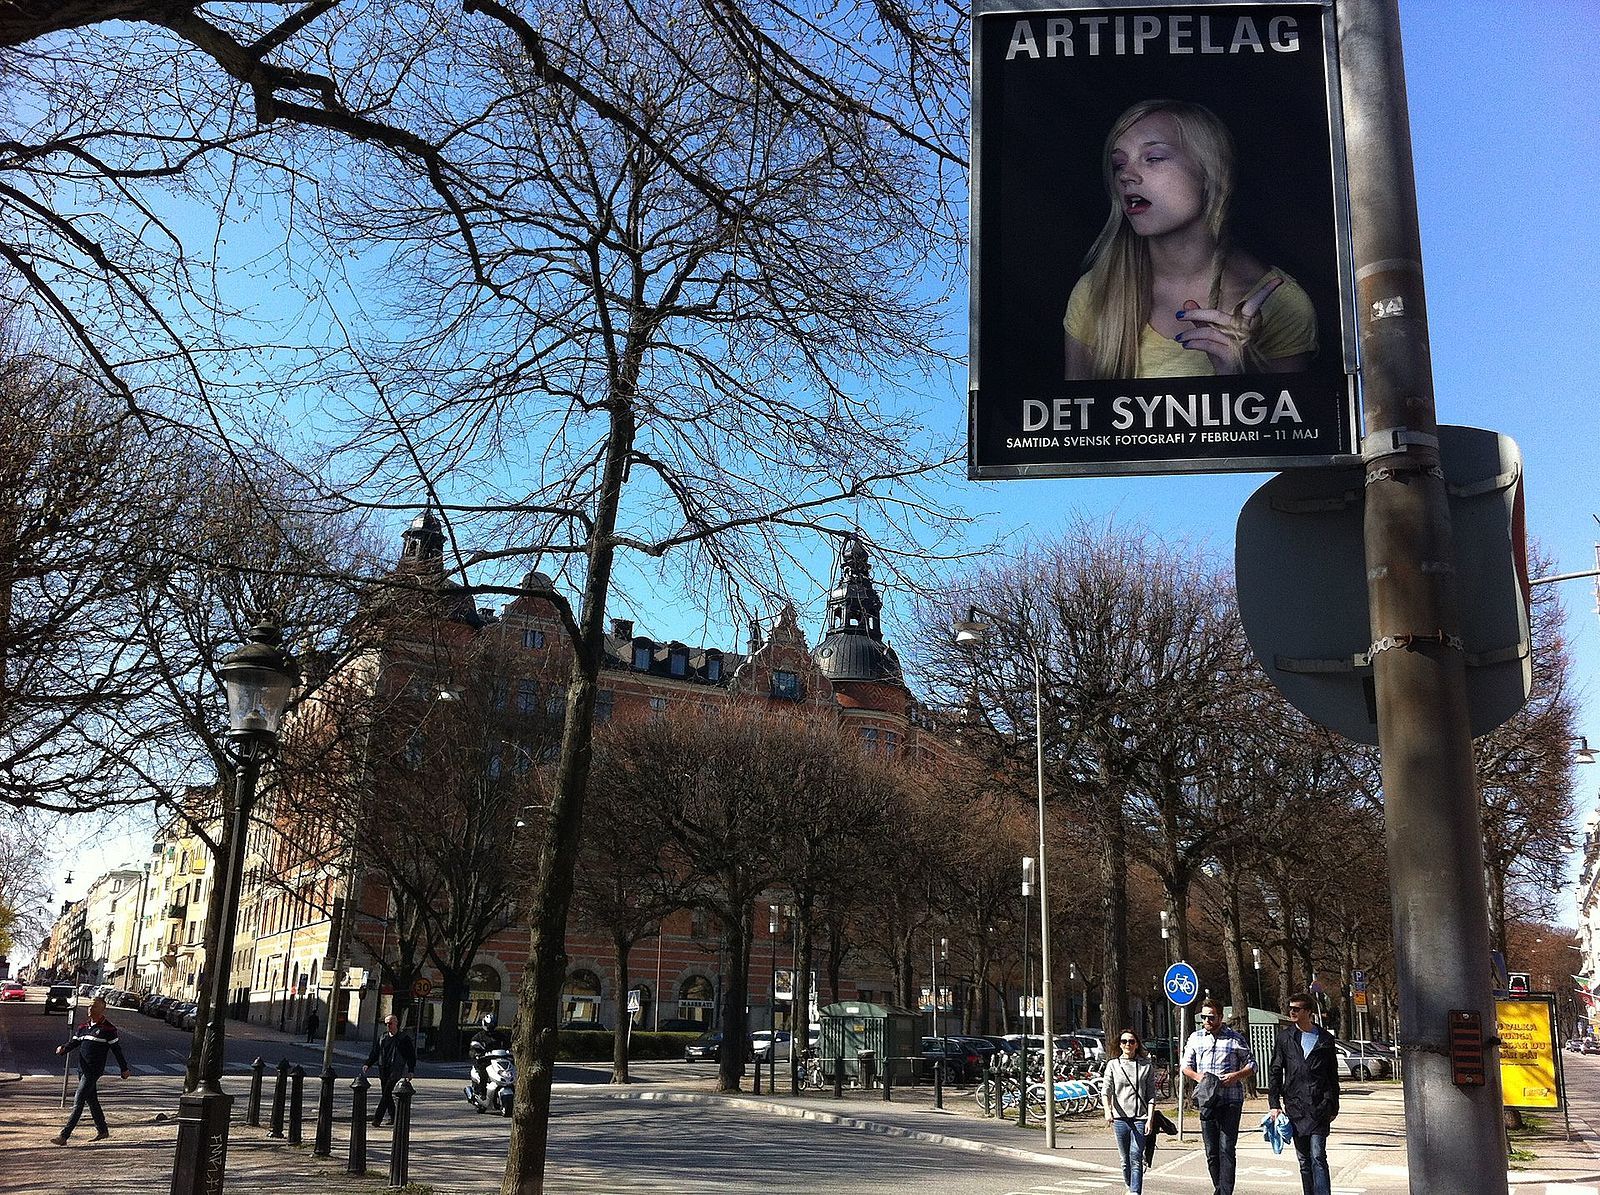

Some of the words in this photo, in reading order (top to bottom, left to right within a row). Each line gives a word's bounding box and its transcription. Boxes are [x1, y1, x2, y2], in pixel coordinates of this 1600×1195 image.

[1005, 15, 1300, 61] ARTIPELAG
[1022, 397, 1096, 432] DET
[1111, 390, 1303, 430] SYNLIGA
[1006, 437, 1060, 448] SAMTIDA
[1063, 436, 1111, 447] SVENSK
[1115, 433, 1185, 446] FOTOGRAFI
[1188, 432, 1197, 443] 7
[1201, 431, 1260, 443] FEBRUARI
[1275, 430, 1286, 440] 11
[1292, 428, 1319, 440] MAJ
[1355, 971, 1362, 981] P
[415, 982, 429, 992] 30
